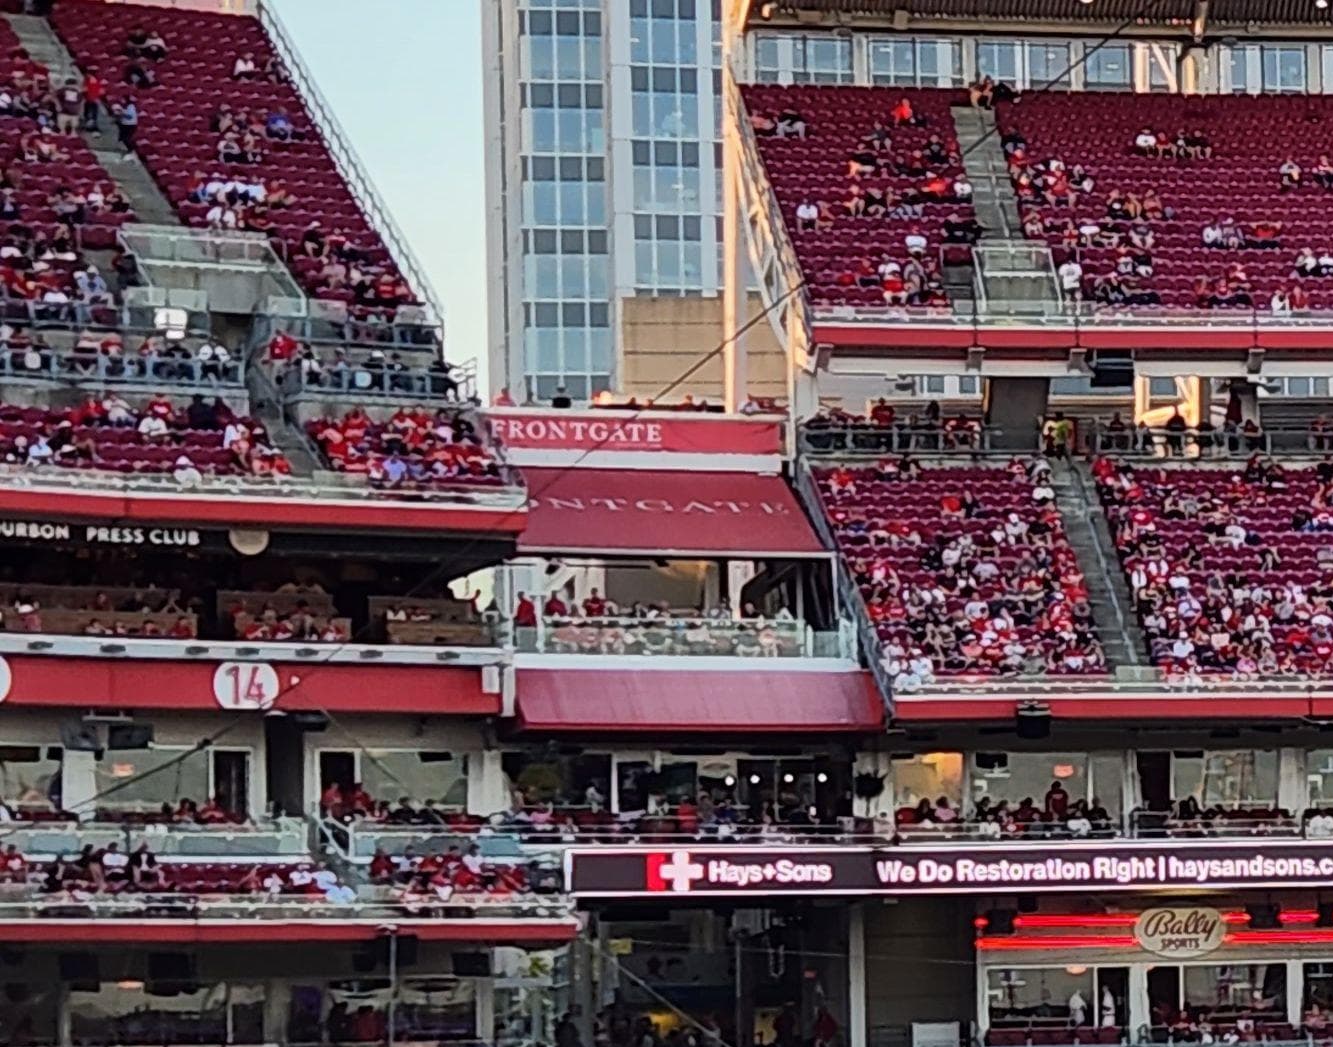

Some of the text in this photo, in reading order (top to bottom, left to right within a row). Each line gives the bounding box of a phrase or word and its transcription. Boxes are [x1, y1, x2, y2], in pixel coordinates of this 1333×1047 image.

[491, 417, 663, 442] FRONTGATE
[528, 497, 790, 515] NTGATE
[0, 522, 200, 546] URBON PRESS CLUB
[225, 664, 266, 705] 14
[708, 859, 833, 886] Hays+Sons
[876, 860, 916, 883] We
[918, 859, 953, 882] Do
[955, 857, 1091, 881] Restoration
[1093, 855, 1156, 882] Right
[1143, 909, 1218, 942] Bally
[1160, 937, 1200, 950] SPORTS
